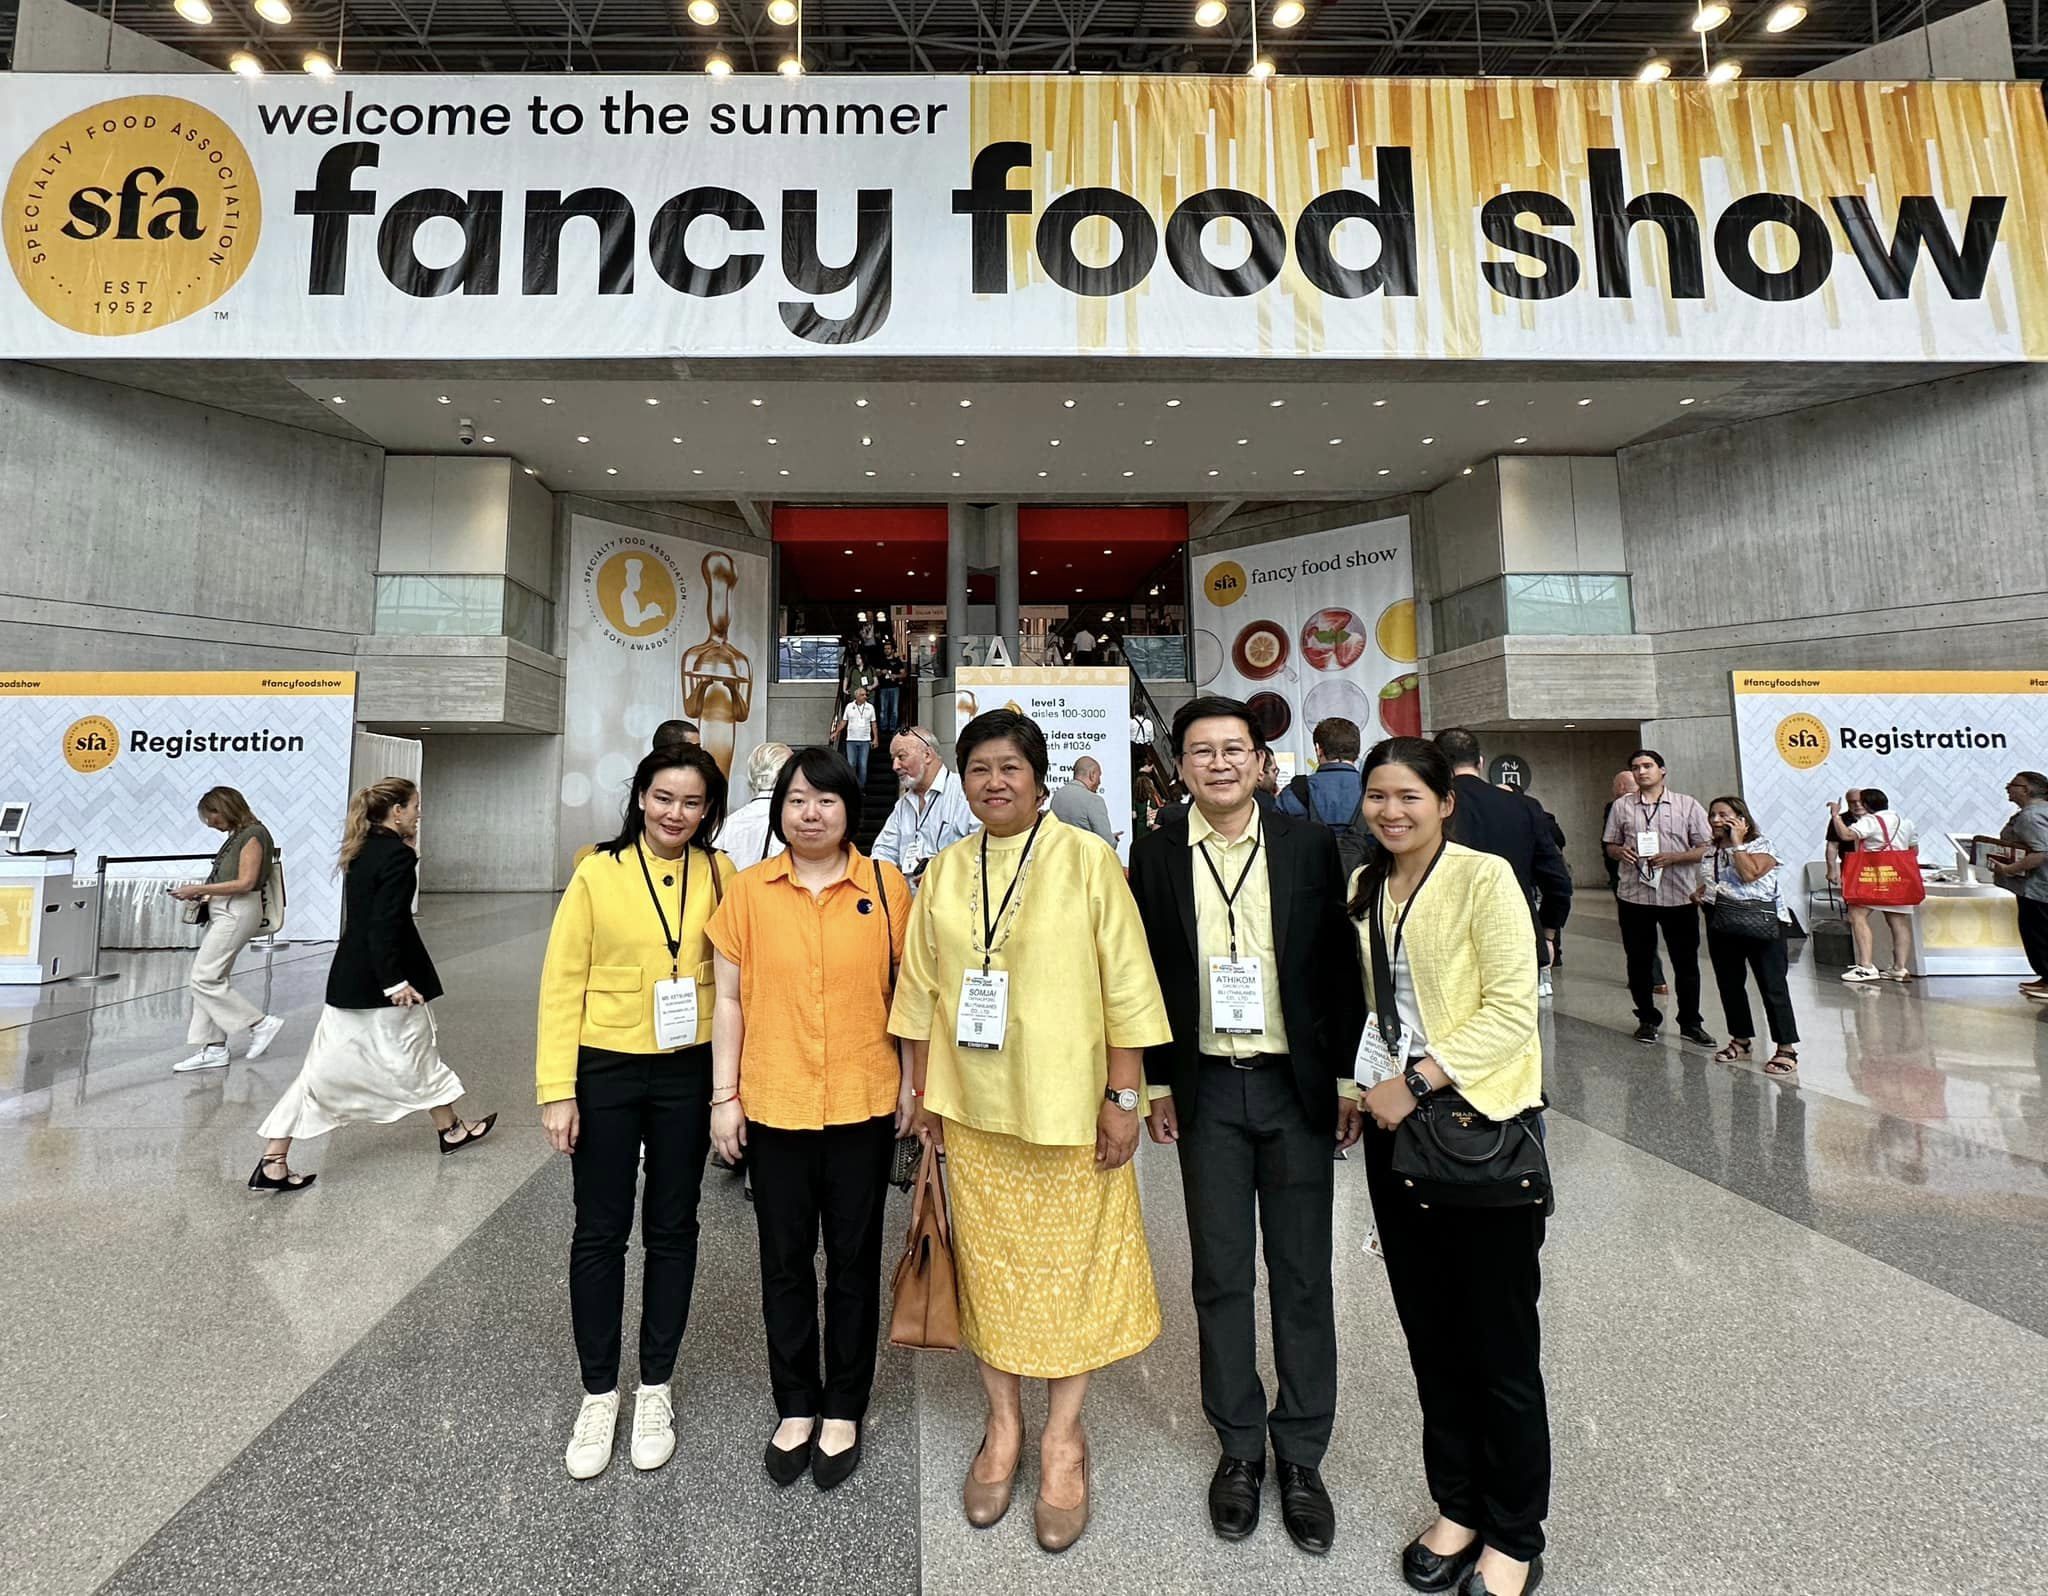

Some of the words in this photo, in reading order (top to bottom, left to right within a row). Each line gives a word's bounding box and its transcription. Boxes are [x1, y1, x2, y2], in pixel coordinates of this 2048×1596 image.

[258, 91, 510, 135] welcome
[528, 96, 583, 135] to
[600, 90, 688, 135] the
[711, 103, 948, 136] summer
[25, 141, 72, 264] SPECIALTY
[86, 116, 157, 139] FOOD
[171, 122, 240, 266] ASSOCIATION
[60, 166, 208, 241] sfa
[294, 142, 892, 344] fancy
[952, 140, 1418, 299] food
[1481, 147, 2006, 302] show
[104, 281, 148, 294] EST
[94, 301, 153, 315] 1952
[584, 541, 616, 584] SPECIALTY
[619, 537, 646, 546] FOOD
[649, 543, 688, 601] ASSOCIATION
[1251, 565, 1298, 584] fancy
[1302, 554, 1341, 576] food
[1346, 548, 1398, 568] show
[1214, 574, 1238, 592] sfa
[630, 637, 669, 651] AWARDS
[261, 678, 342, 691] #fancyfoodshow
[1743, 677, 1821, 690] #fancyfoodshow
[1031, 698, 1056, 707] level
[1058, 698, 1065, 707] 3
[1031, 709, 1059, 718] aisles
[1061, 709, 1106, 718] 100-3000
[75, 732, 107, 751] sfa
[130, 729, 304, 759] Registration
[1051, 730, 1074, 740] idea
[1077, 731, 1107, 742] stage
[1788, 729, 1819, 747] sfa
[1840, 727, 2007, 755] Registration
[1063, 741, 1092, 751] #1036
